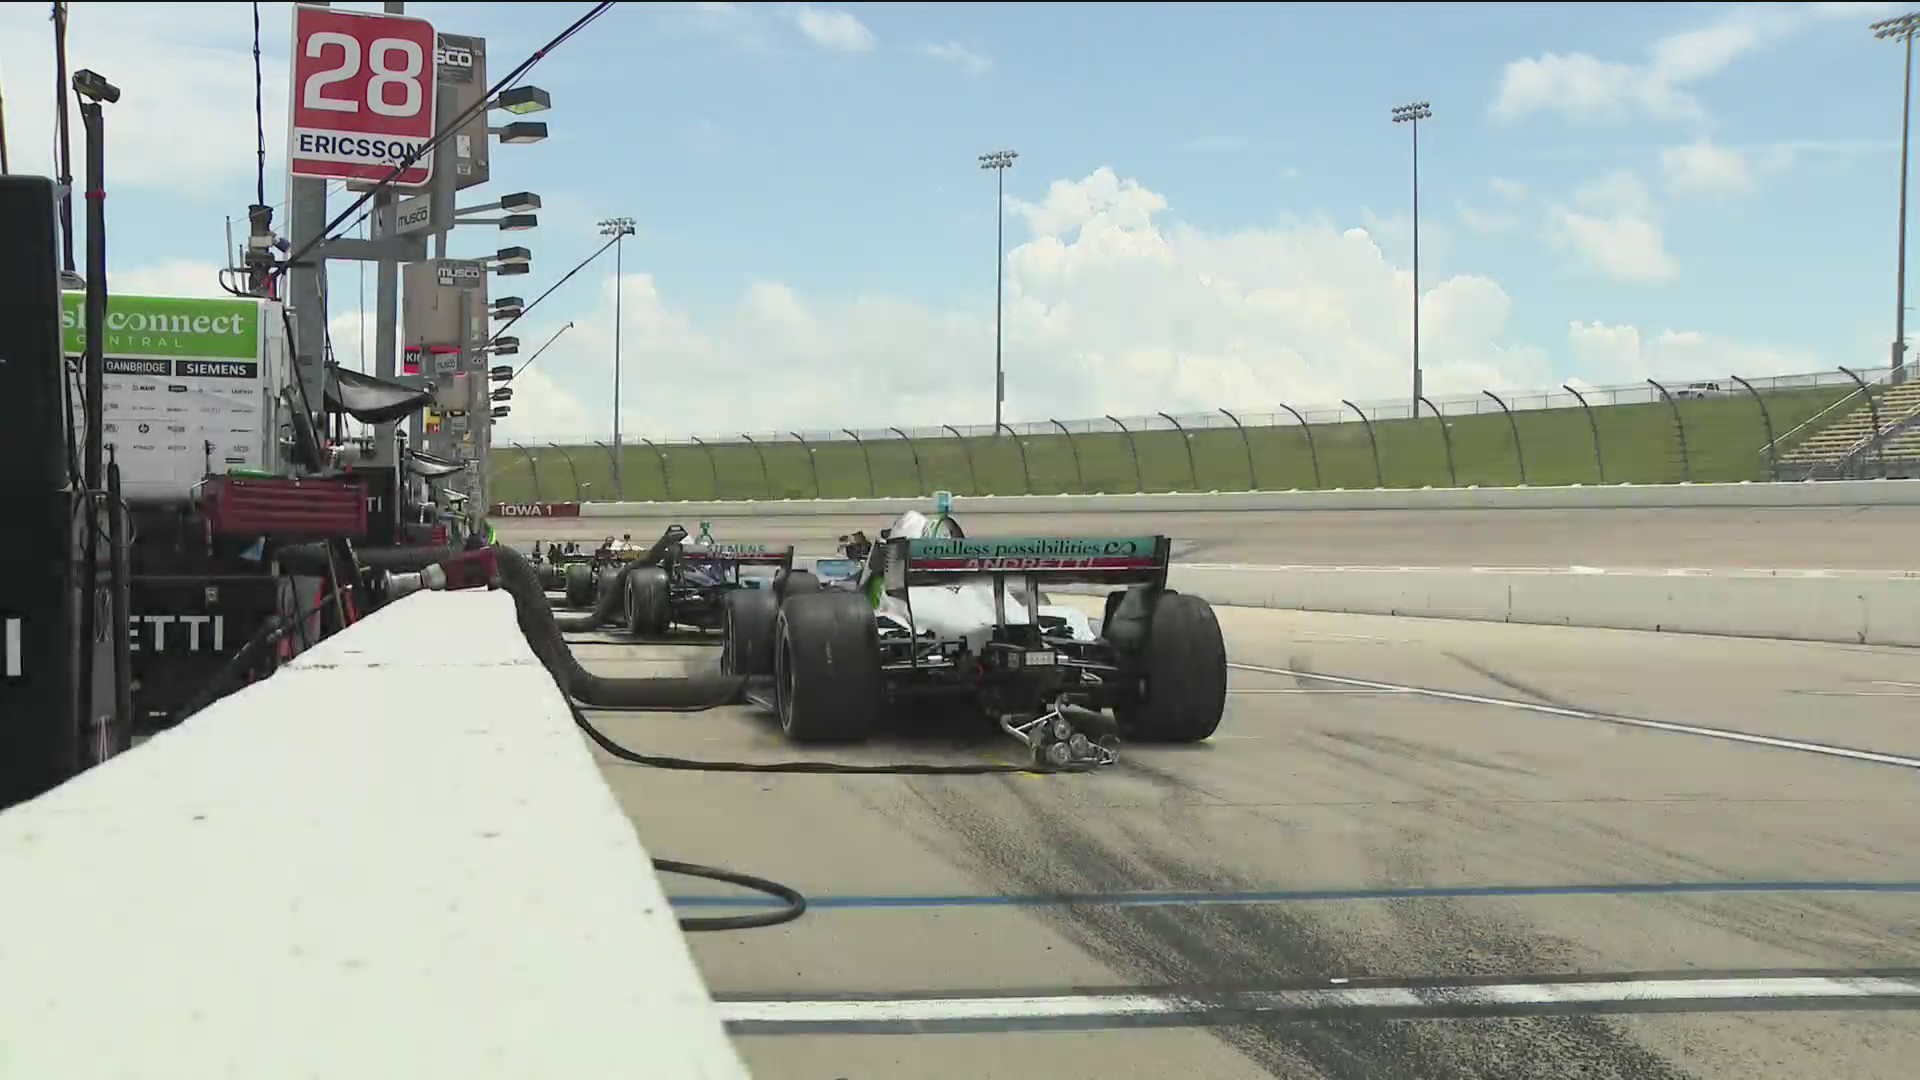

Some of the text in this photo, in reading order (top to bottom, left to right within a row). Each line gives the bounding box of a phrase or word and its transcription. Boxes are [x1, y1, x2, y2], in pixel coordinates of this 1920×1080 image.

[304, 31, 424, 118] 28
[300, 134, 422, 161] ERICSSON
[106, 361, 166, 374] GAINBRIDGE
[186, 362, 247, 376] SIEMENS
[501, 505, 552, 516] IOWA 1
[922, 539, 990, 556] endless
[995, 539, 1100, 557] possibilities
[965, 556, 1096, 570] ANDRETTI
